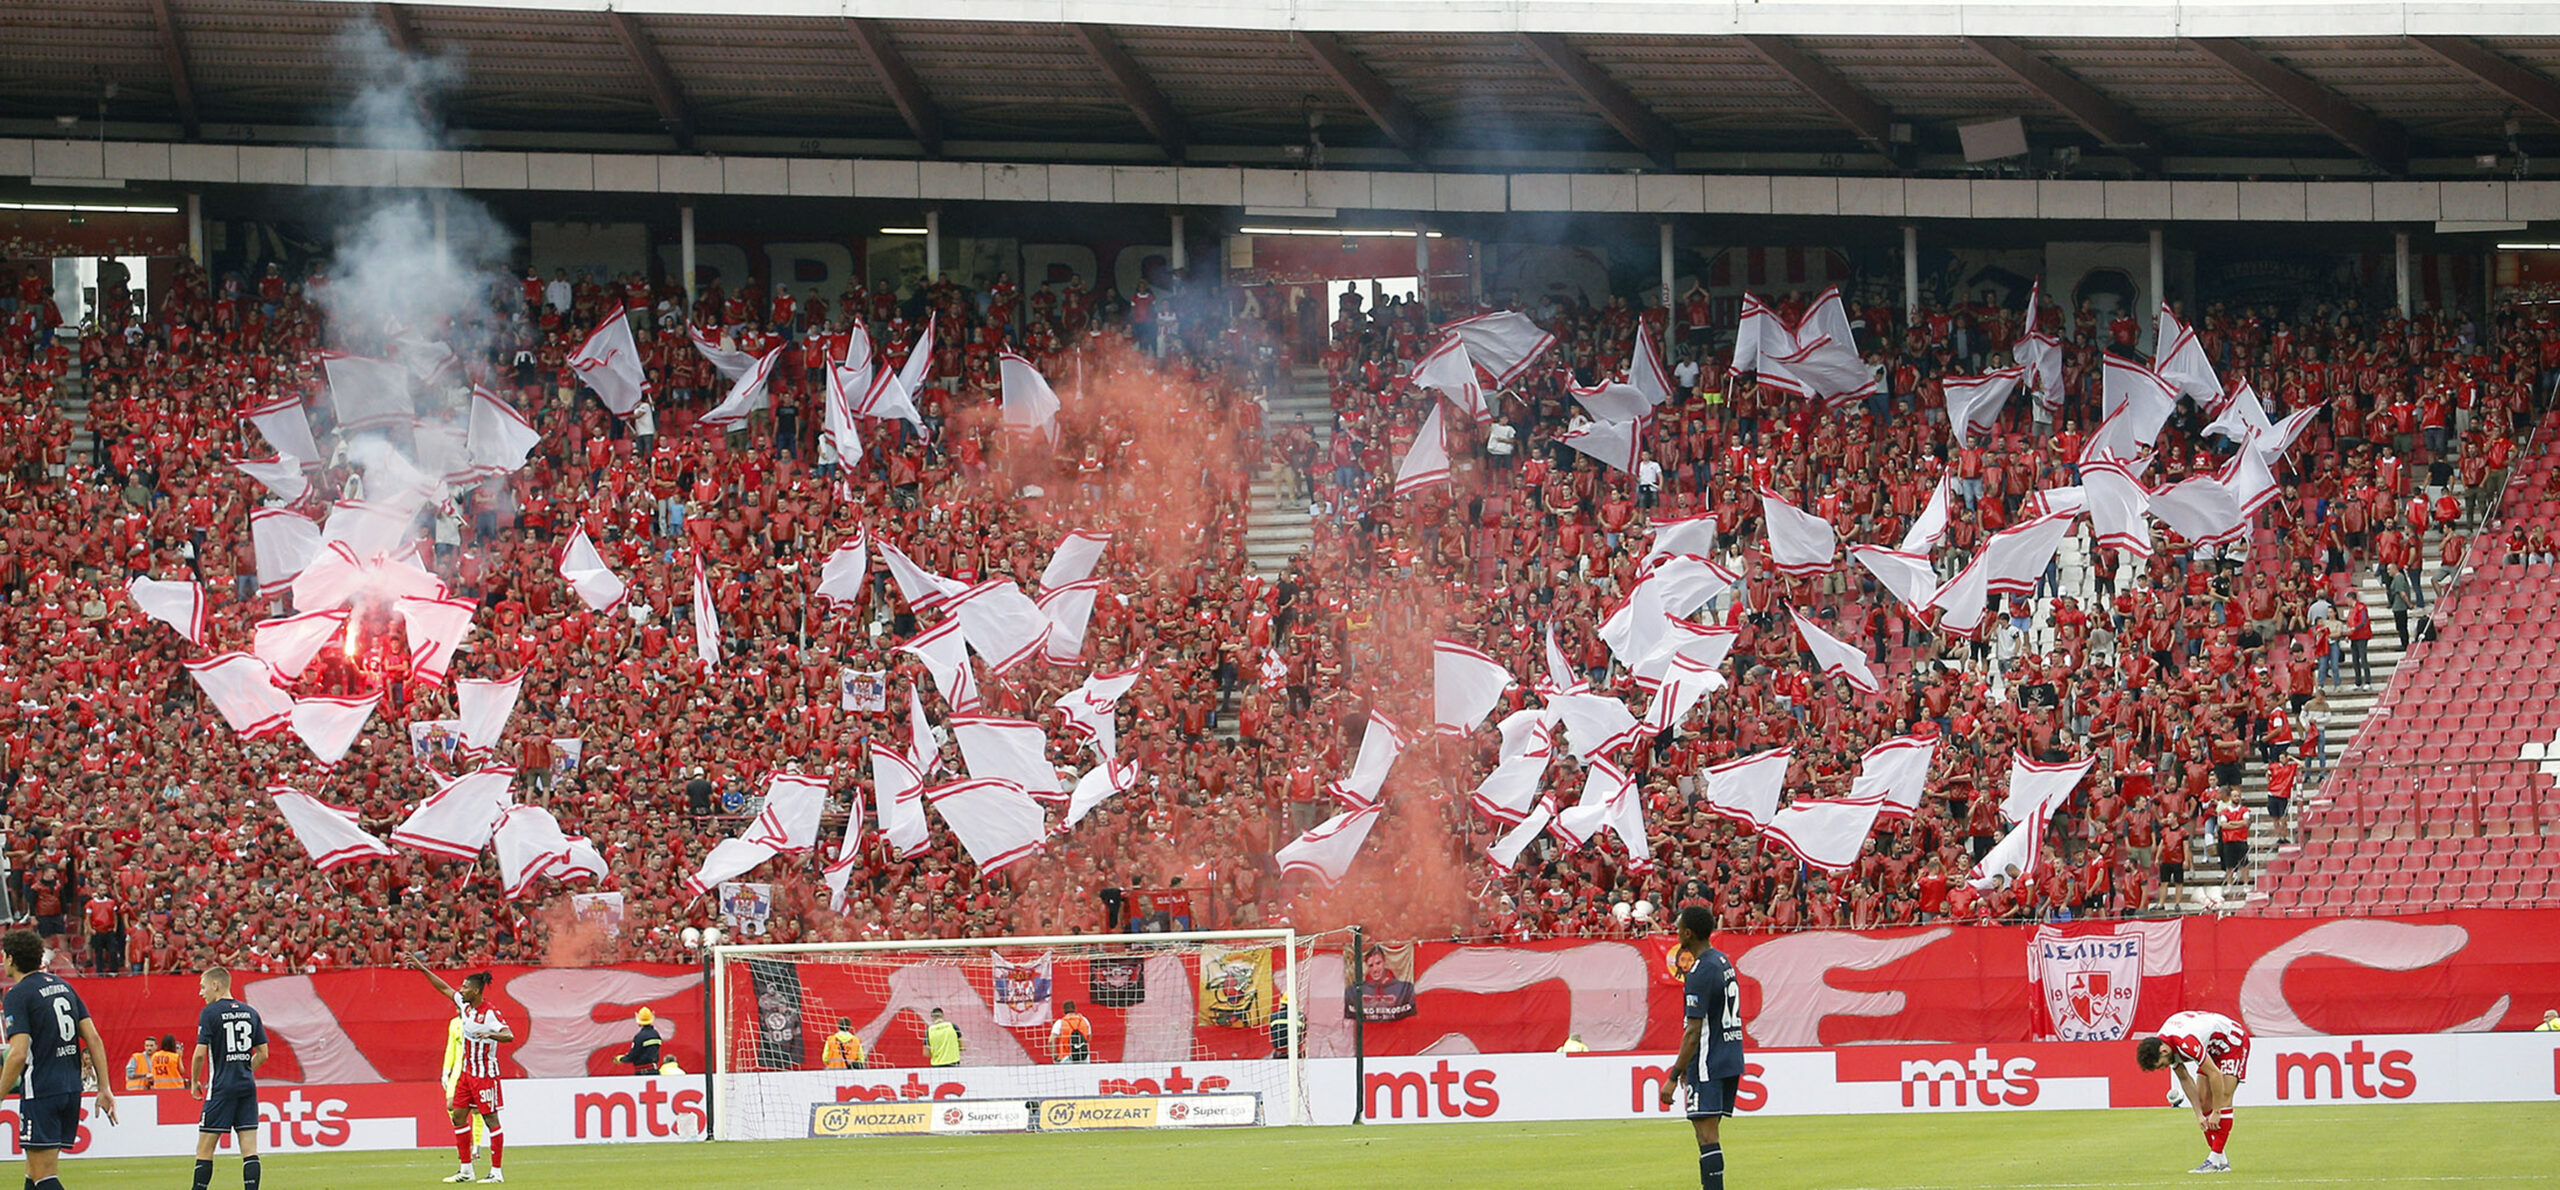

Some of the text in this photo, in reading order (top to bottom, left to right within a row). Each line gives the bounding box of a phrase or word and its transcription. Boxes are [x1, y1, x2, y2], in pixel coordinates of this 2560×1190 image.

[2044, 941, 2138, 960] ДЕЛИЈЕ
[1721, 980, 1742, 1029] 12
[2113, 987, 2133, 1000] 89
[53, 996, 76, 1042] 6
[223, 1020, 252, 1053] 13
[1900, 1046, 2040, 1107] mts
[2220, 1059, 2235, 1074] 23
[2277, 1040, 2417, 1099] mts
[479, 1088, 492, 1103] 30
[1364, 1059, 1500, 1118] mts
[575, 1080, 707, 1138] mts
[854, 1113, 926, 1126] MOZZART
[1079, 1107, 1151, 1120] MOZZART
